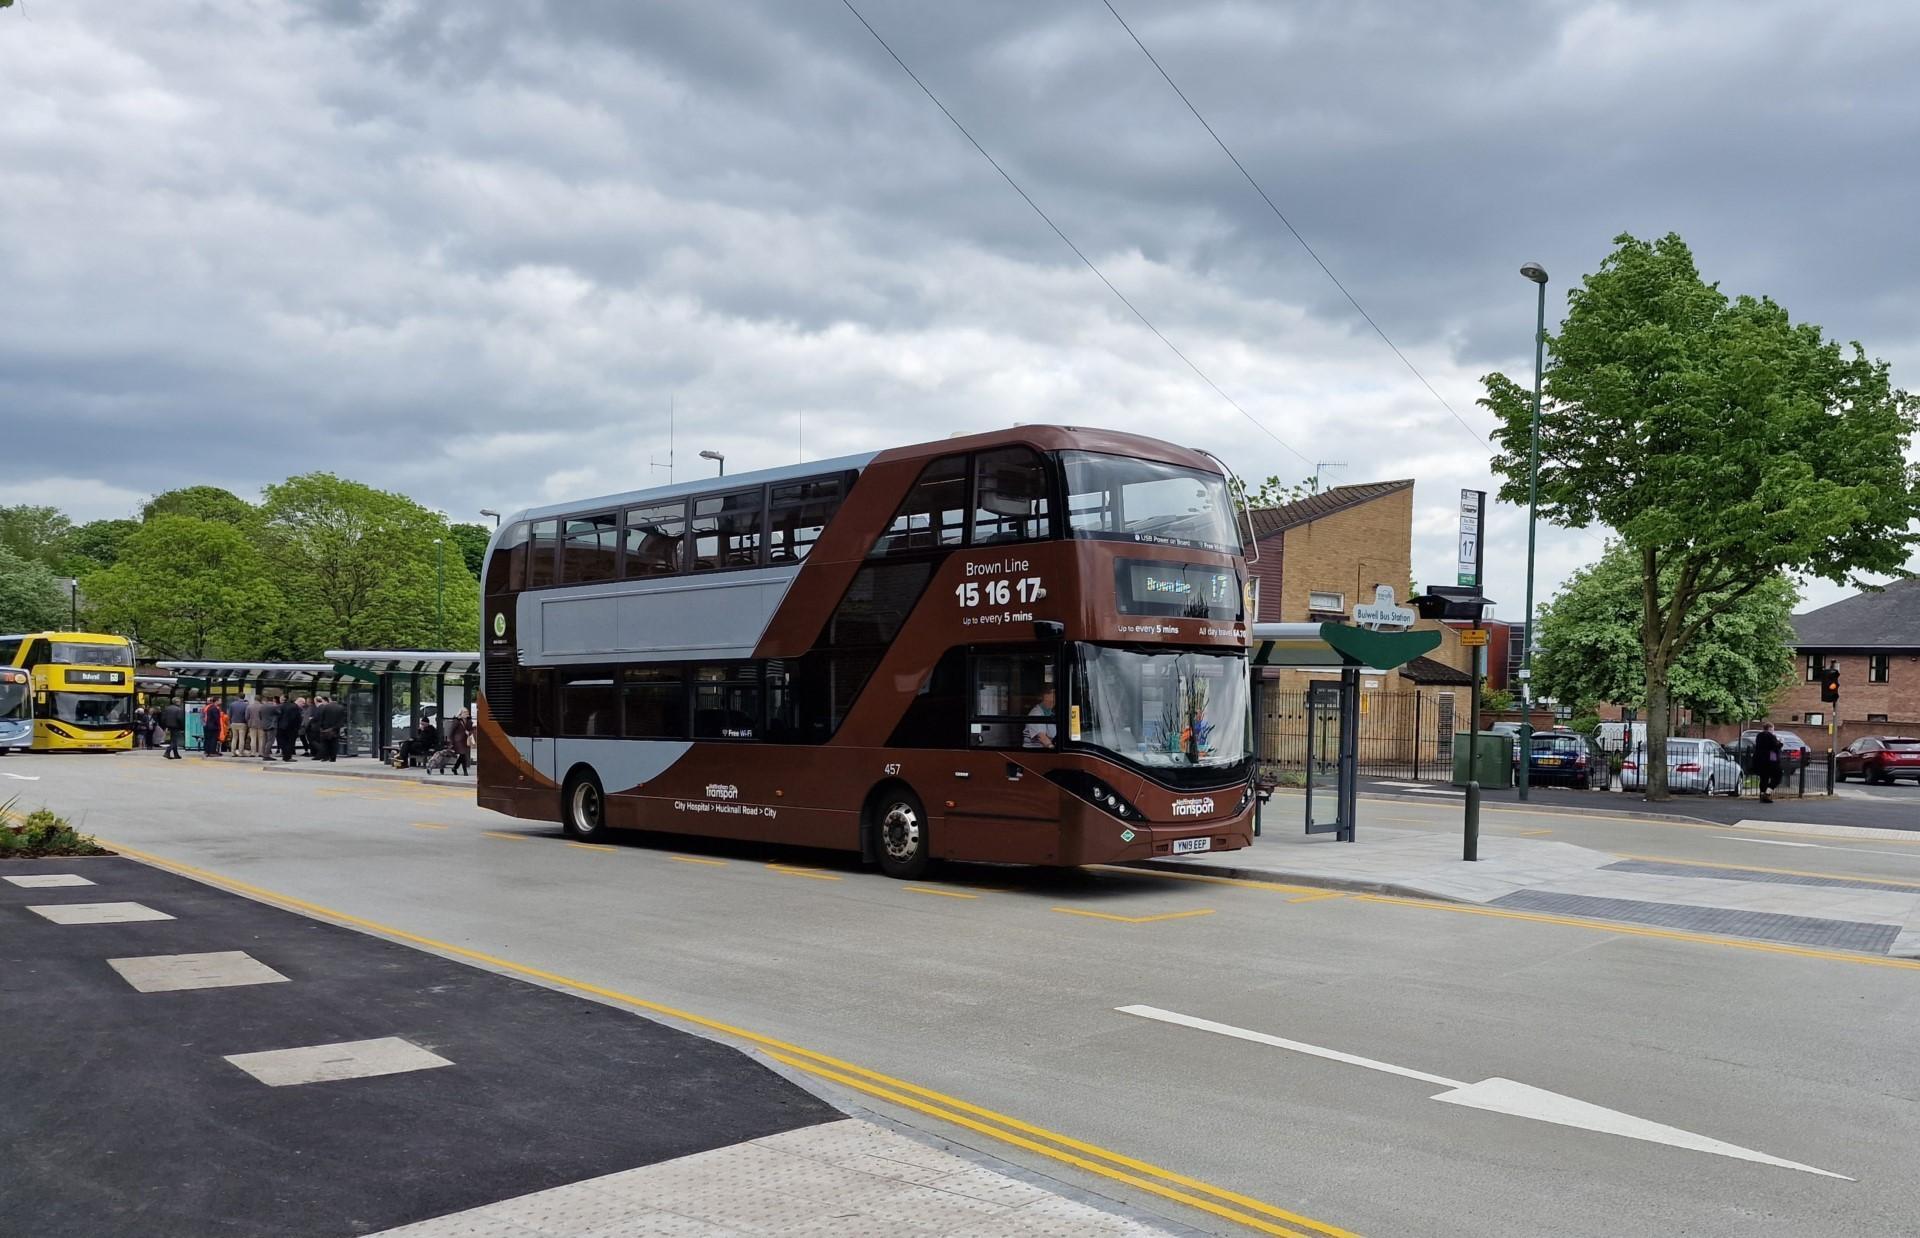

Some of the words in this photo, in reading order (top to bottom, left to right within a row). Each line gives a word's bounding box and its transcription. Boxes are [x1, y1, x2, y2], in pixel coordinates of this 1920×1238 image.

[1462, 540, 1475, 557] 17
[966, 562, 1001, 576] Brown
[1005, 559, 1029, 573] Line
[955, 582, 979, 607] 15
[985, 580, 1010, 605] 16
[1016, 577, 1041, 603] 17
[980, 615, 1002, 624] every
[1004, 612, 1010, 622] 5
[1012, 611, 1033, 622] mins
[1357, 609, 1378, 620] Bulwell
[1380, 610, 1390, 620] Bus
[1391, 611, 1411, 622] Station
[1135, 625, 1155, 634] every
[1156, 625, 1162, 633] 5
[1162, 625, 1179, 634] mins
[1207, 627, 1217, 637] day
[884, 763, 901, 775] 457
[706, 786, 738, 800] Transport
[674, 801, 685, 811] City
[686, 802, 710, 813] Hospital
[715, 804, 741, 814] Hucknall
[742, 806, 758, 815] Road
[764, 807, 776, 819] City
[1172, 802, 1214, 816] Transport
[1178, 840, 1193, 850] YN19
[1194, 839, 1206, 849] EEP
